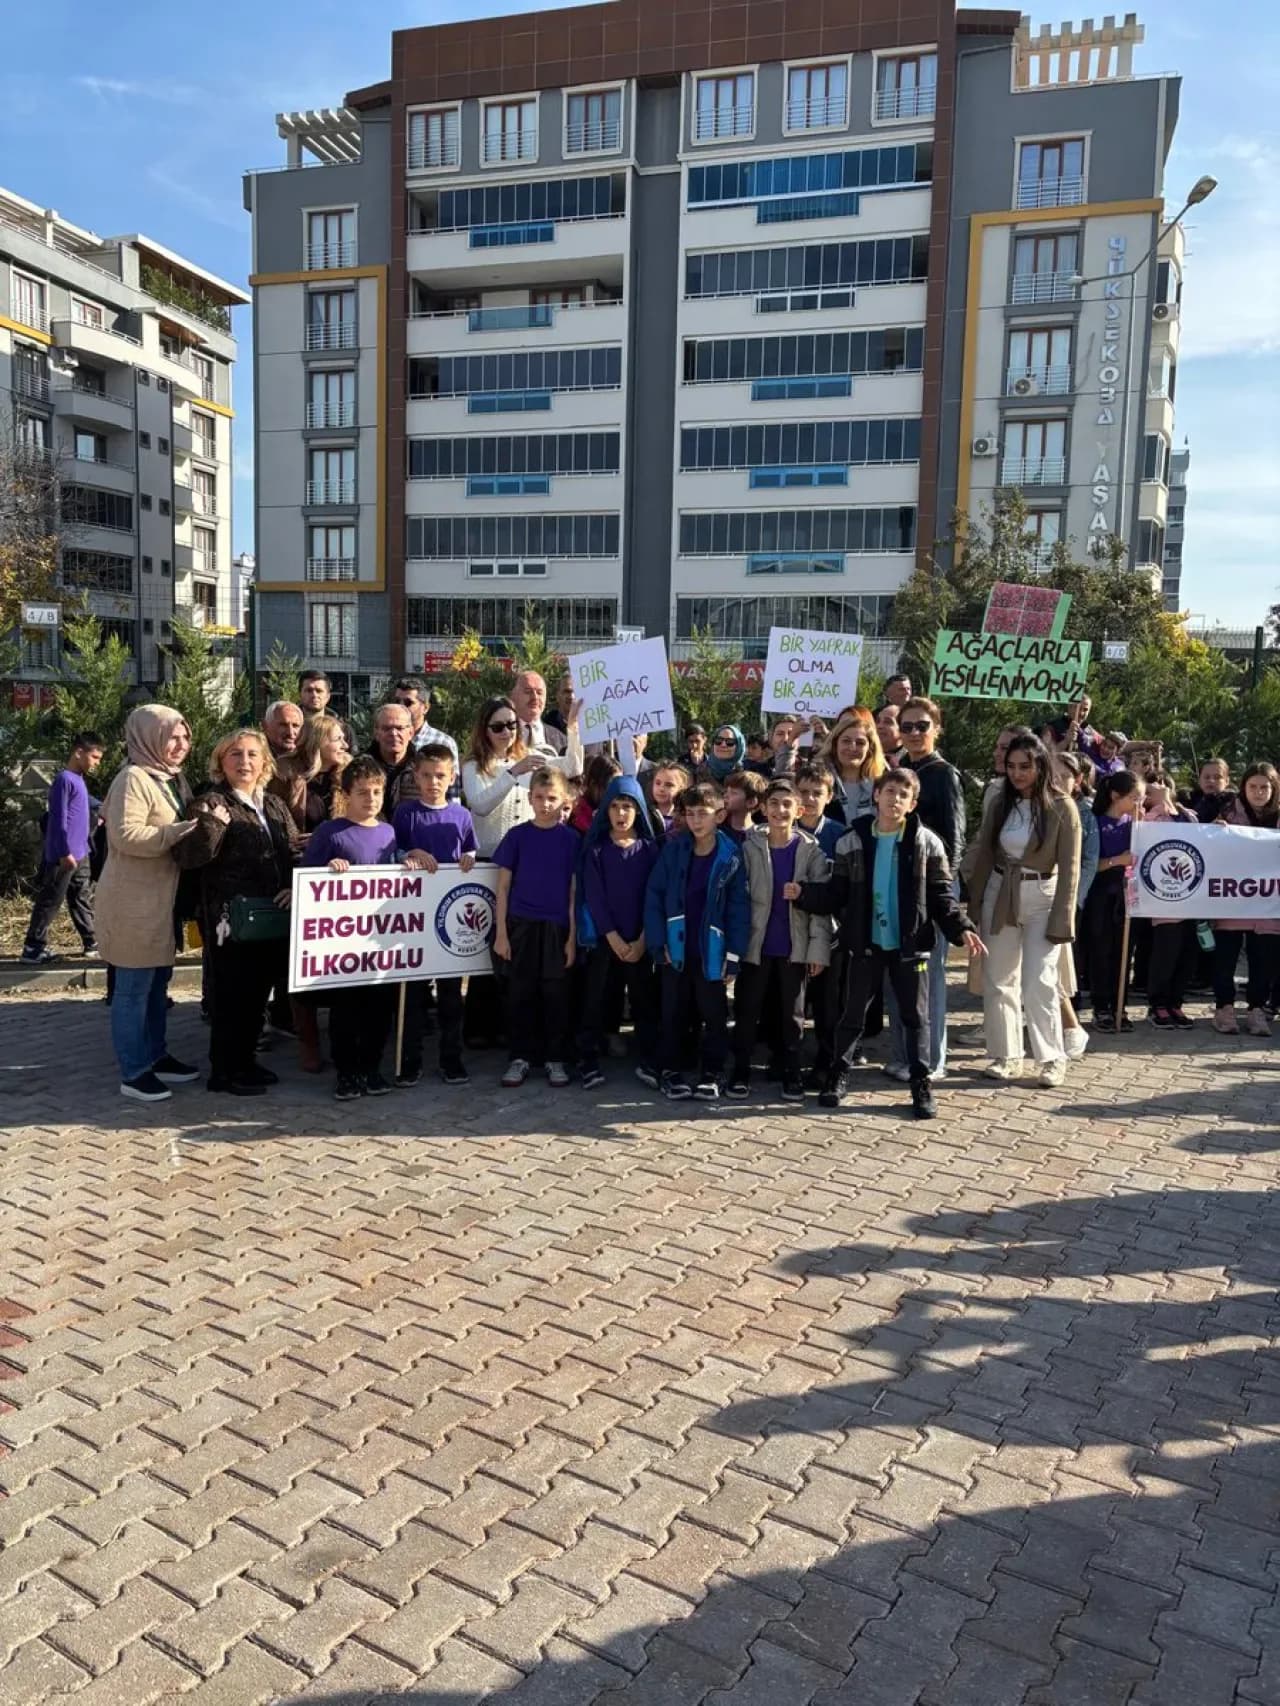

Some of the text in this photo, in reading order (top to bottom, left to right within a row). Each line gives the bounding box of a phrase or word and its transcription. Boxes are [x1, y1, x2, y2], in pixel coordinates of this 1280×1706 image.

[780, 632, 861, 656] BİR YAPRAK
[946, 632, 1082, 664] AĞAÇLARLA
[579, 658, 608, 689] BİR
[788, 658, 835, 675] OLMA
[602, 674, 651, 703] AĞAÇ
[773, 677, 840, 699] BİR AĞAÇ
[933, 662, 1086, 703] YEŞİLLENİYORUZ
[584, 702, 613, 730] BİR
[606, 709, 665, 738] HAYAT
[309, 876, 422, 902] YILDIRIM
[303, 912, 425, 941] ERGUVAN
[301, 947, 424, 978] İLKOKULU
